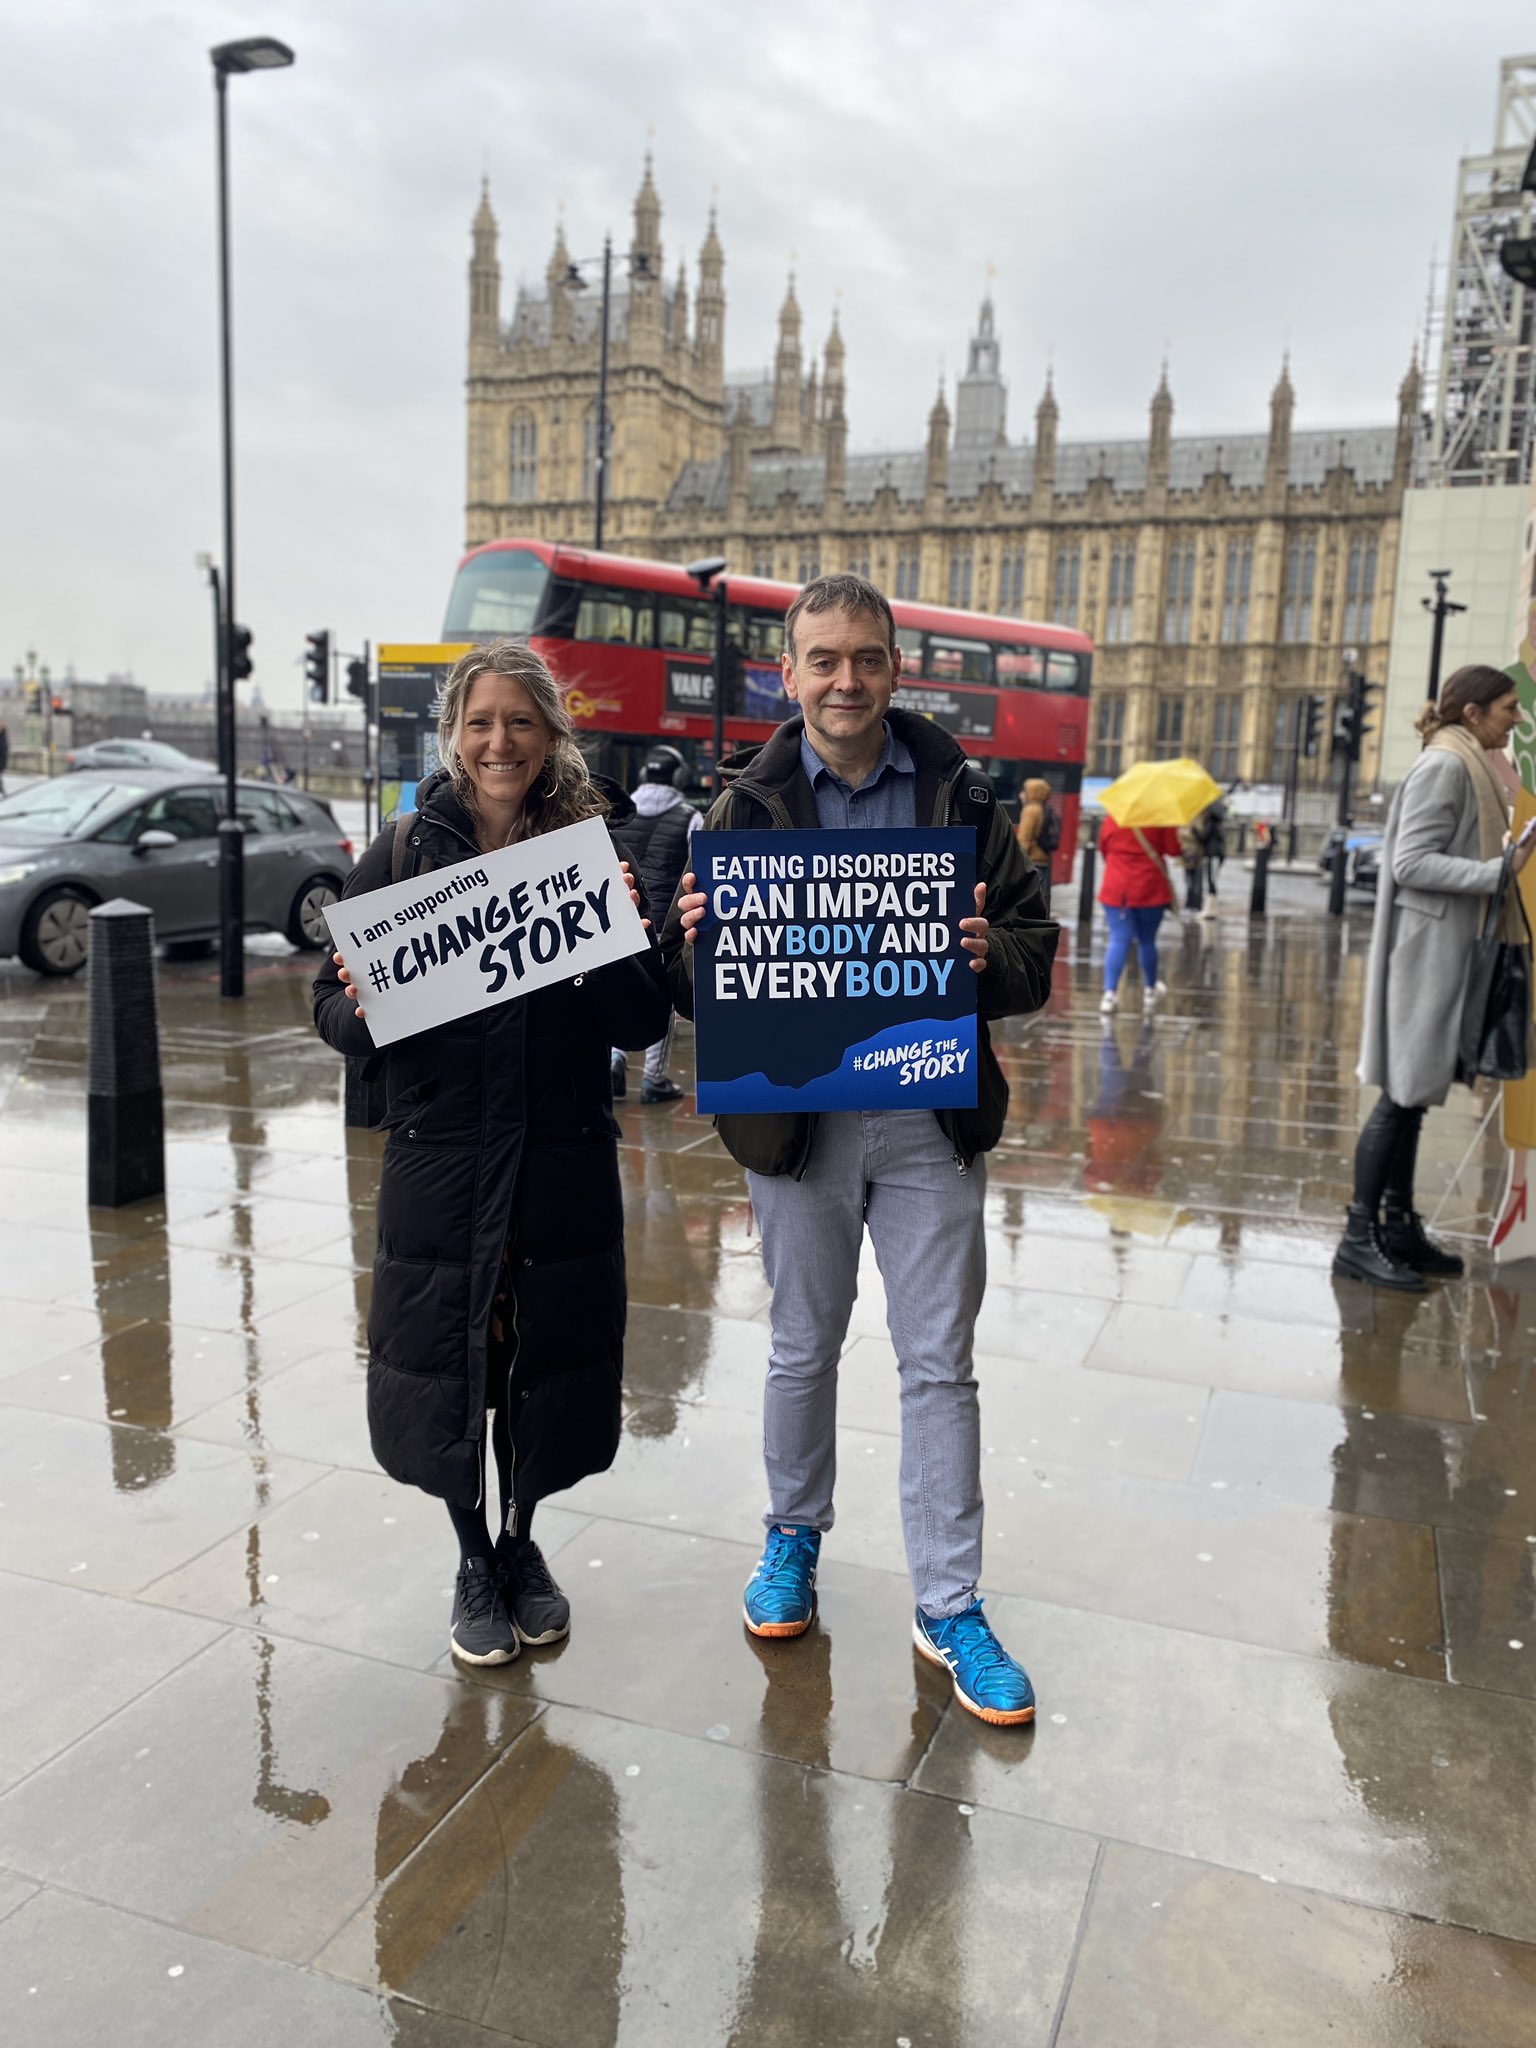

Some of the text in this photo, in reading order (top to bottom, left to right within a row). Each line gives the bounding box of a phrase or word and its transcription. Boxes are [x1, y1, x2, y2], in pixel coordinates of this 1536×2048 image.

[712, 852, 955, 880] EATING DISORDERS
[349, 868, 490, 948] I am supporting
[713, 880, 955, 920] CAN IMPACT
[368, 863, 583, 993] #CHANGE THE
[479, 878, 610, 993] STORY
[714, 922, 950, 957] ANYBODY AND
[715, 958, 955, 1000] EVERYBODY
[853, 1037, 958, 1071] #CHANGE THE
[899, 1048, 970, 1085] STORY
